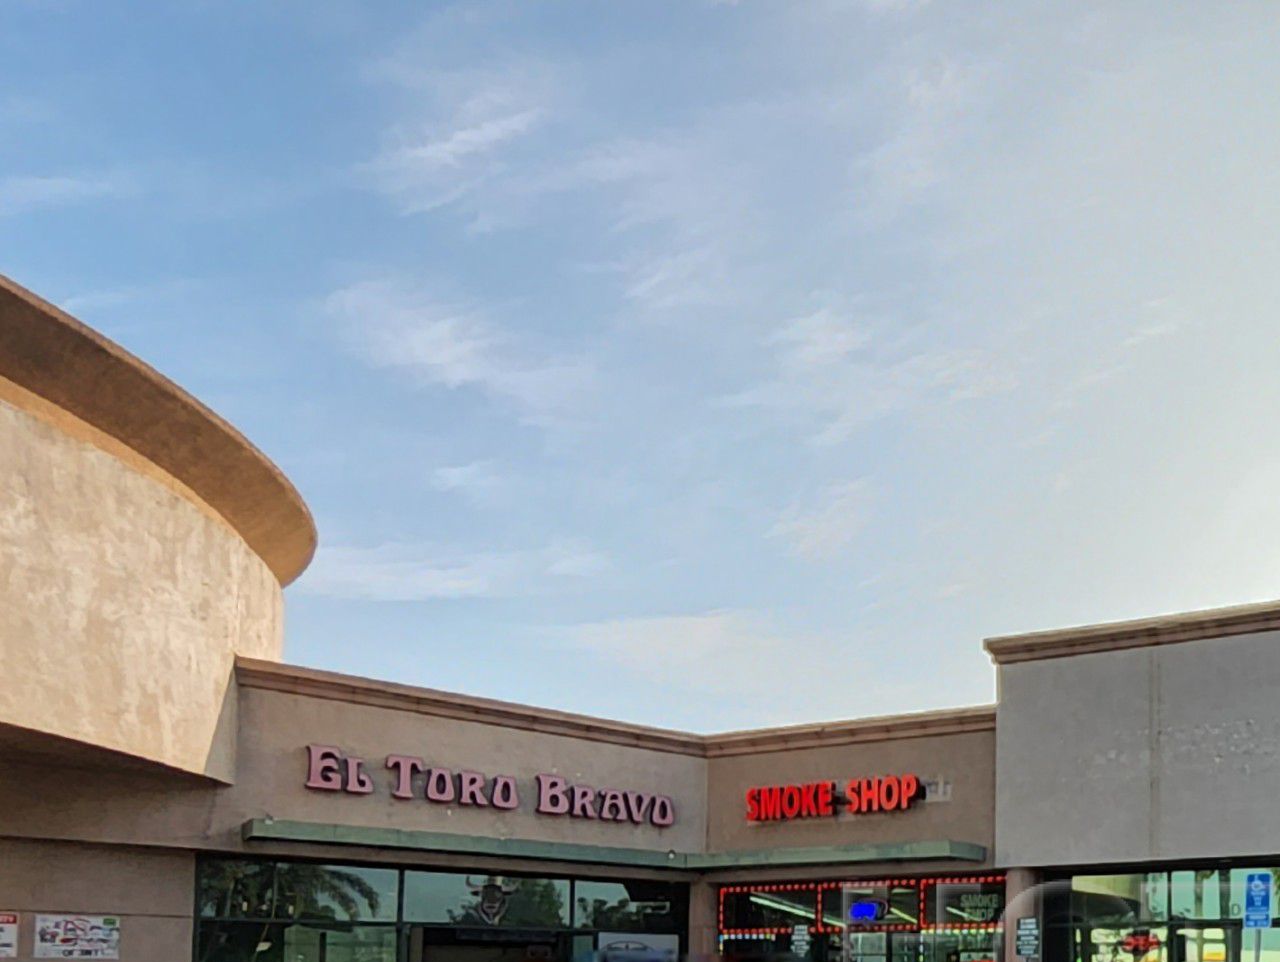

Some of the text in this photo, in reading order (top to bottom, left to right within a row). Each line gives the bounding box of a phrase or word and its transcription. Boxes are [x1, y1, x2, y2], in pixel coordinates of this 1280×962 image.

[305, 743, 675, 828] EL TORO BRAVO
[745, 780, 835, 822] SMOKE
[845, 773, 919, 814] SHOP
[960, 894, 998, 908] SMOKE
